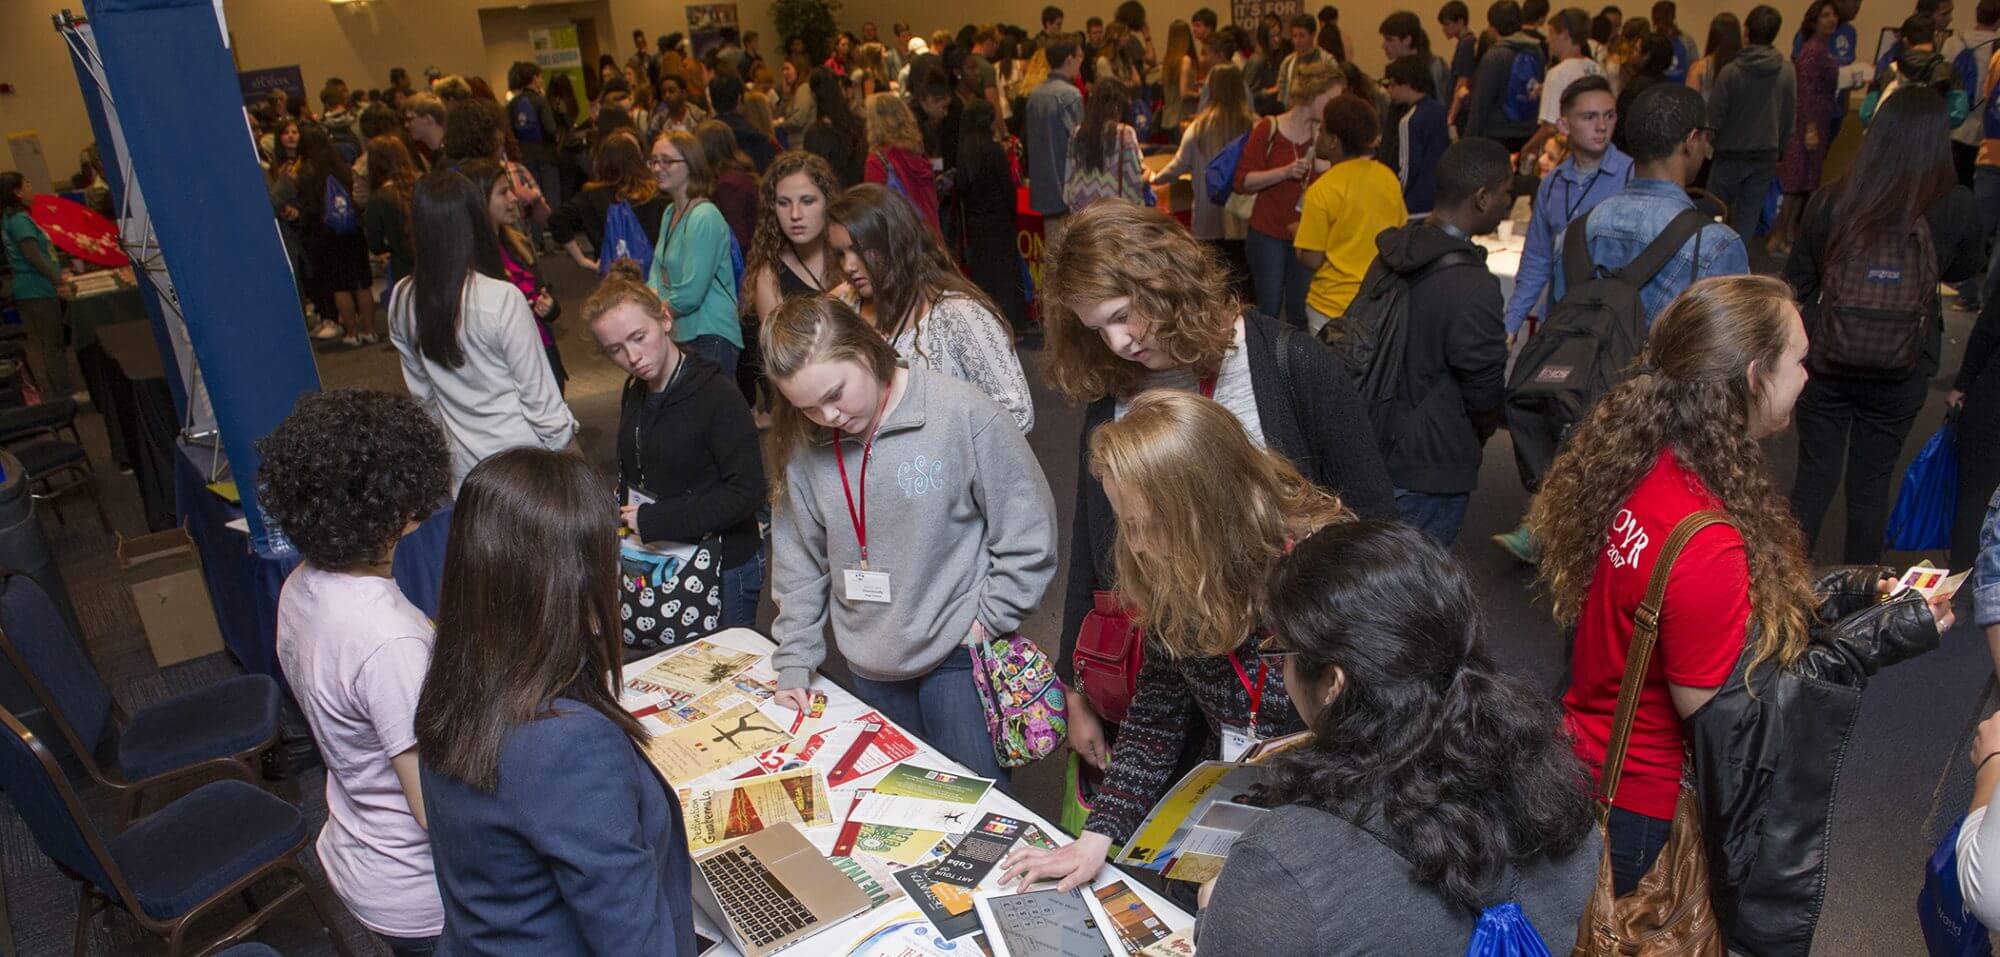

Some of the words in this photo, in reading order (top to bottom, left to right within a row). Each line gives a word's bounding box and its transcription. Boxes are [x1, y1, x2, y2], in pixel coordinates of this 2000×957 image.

[1265, 1, 1297, 16] FOR
[1607, 544, 1626, 568] 2017
[702, 790, 716, 845] Guatemala
[947, 858, 974, 870] Cuba
[934, 870, 955, 880] TOUR
[956, 875, 974, 883] ART
